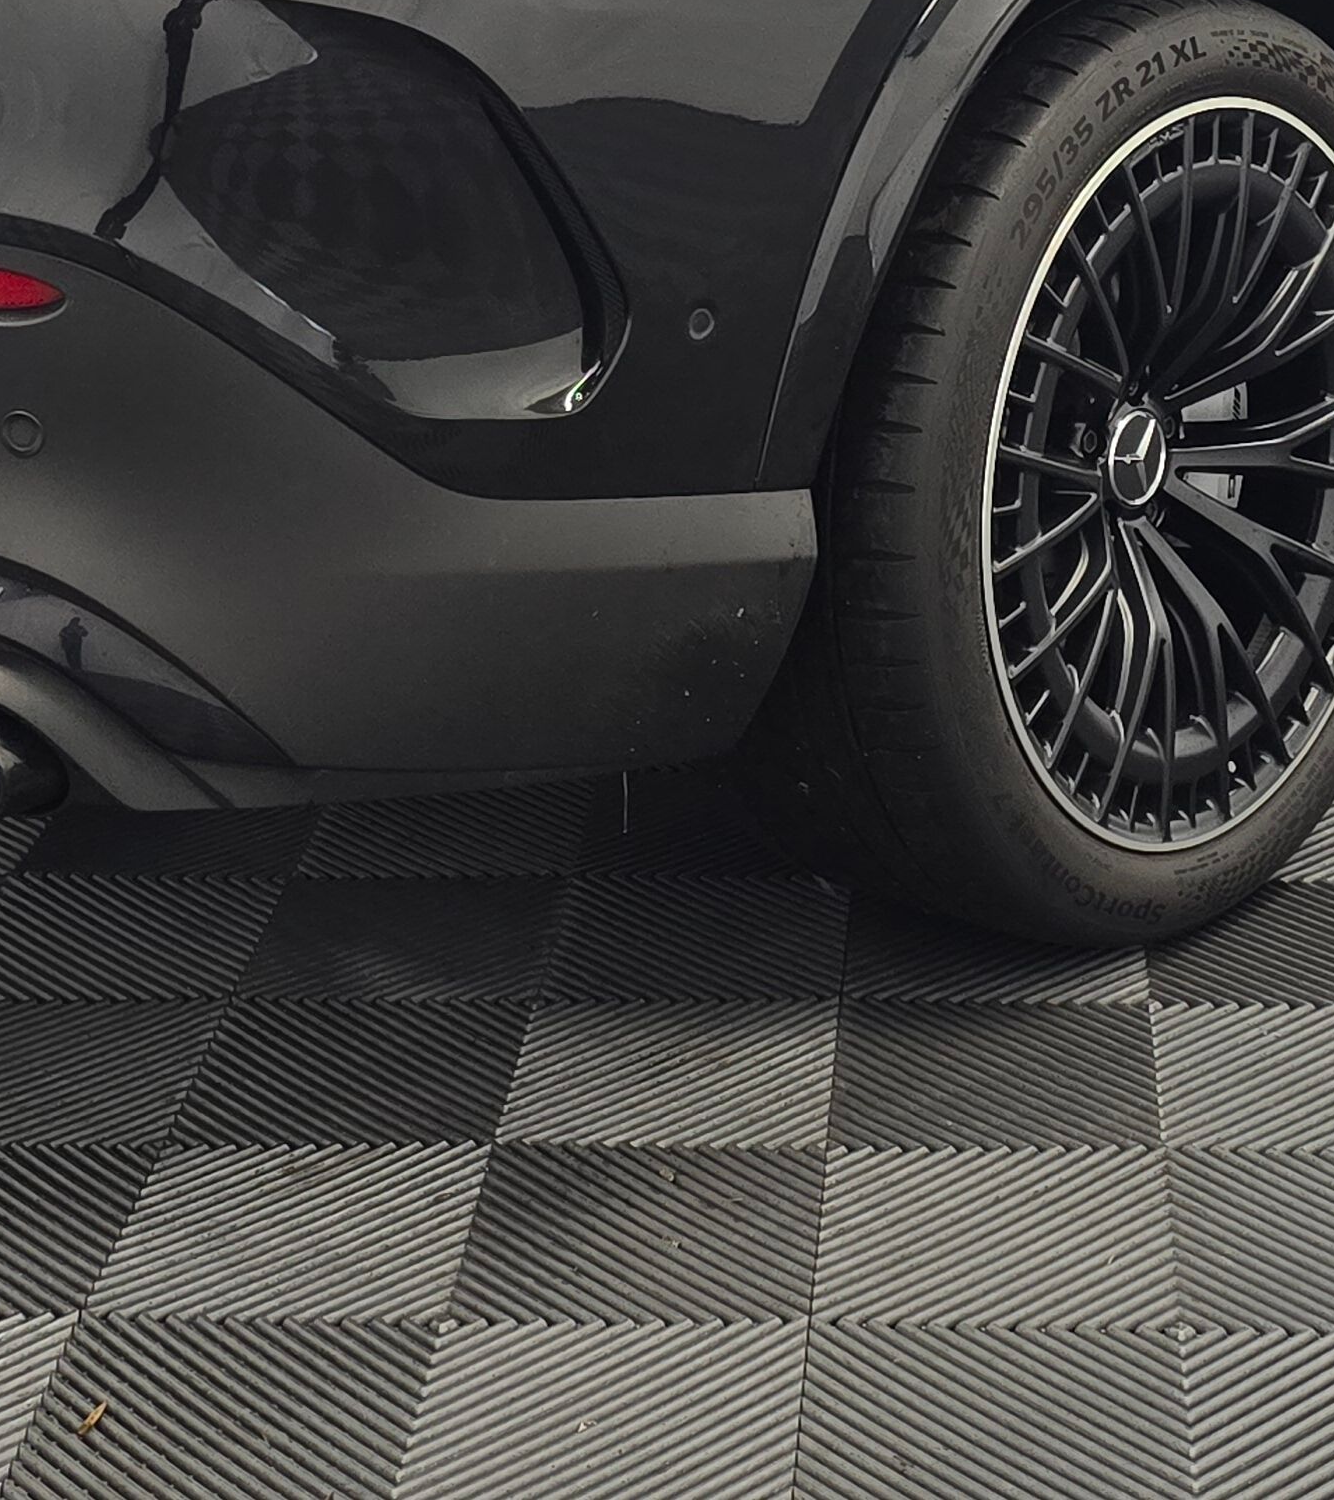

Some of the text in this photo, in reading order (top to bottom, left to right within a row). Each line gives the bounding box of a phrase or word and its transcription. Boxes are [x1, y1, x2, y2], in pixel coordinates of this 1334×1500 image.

[1010, 115, 1094, 250] 295/35
[1095, 75, 1135, 122] ZR
[1136, 51, 1166, 88] 21
[1170, 35, 1207, 67] XL
